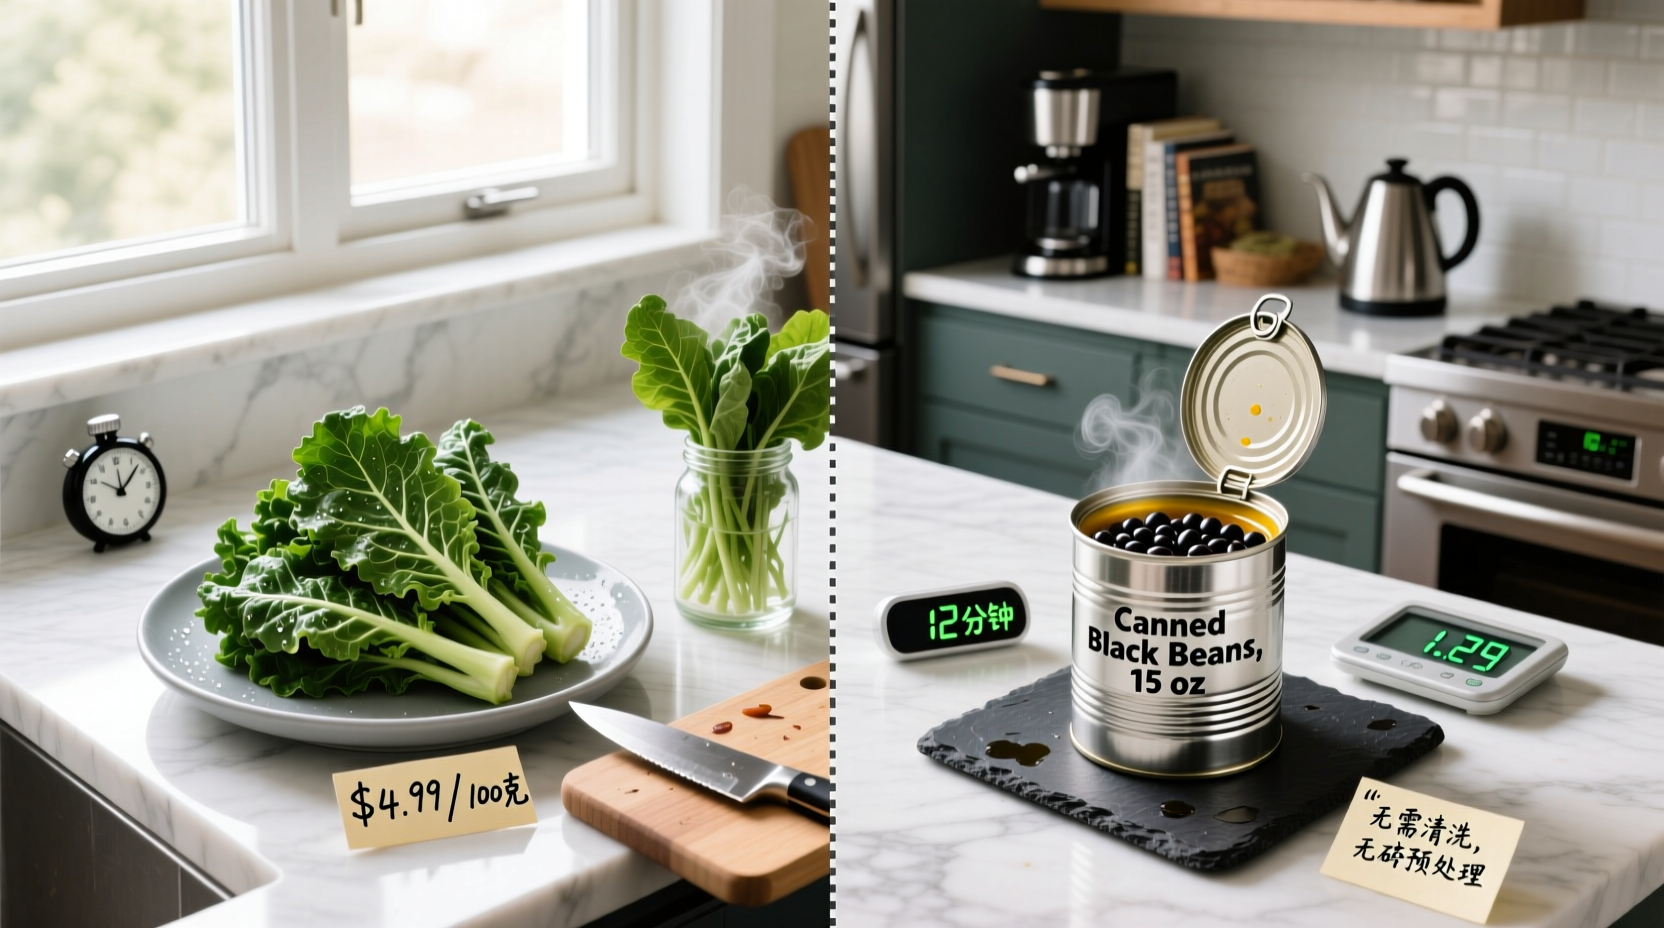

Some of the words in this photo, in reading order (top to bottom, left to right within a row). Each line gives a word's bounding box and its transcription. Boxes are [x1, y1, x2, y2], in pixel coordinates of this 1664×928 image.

[929, 600, 1014, 640] 12分钟
[1114, 606, 1226, 637] Canned
[1088, 625, 1159, 666] Black
[1168, 638, 1263, 667] Beans,
[1423, 630, 1511, 672] 1.29
[1130, 668, 1162, 694] 15
[1170, 676, 1206, 695] oz
